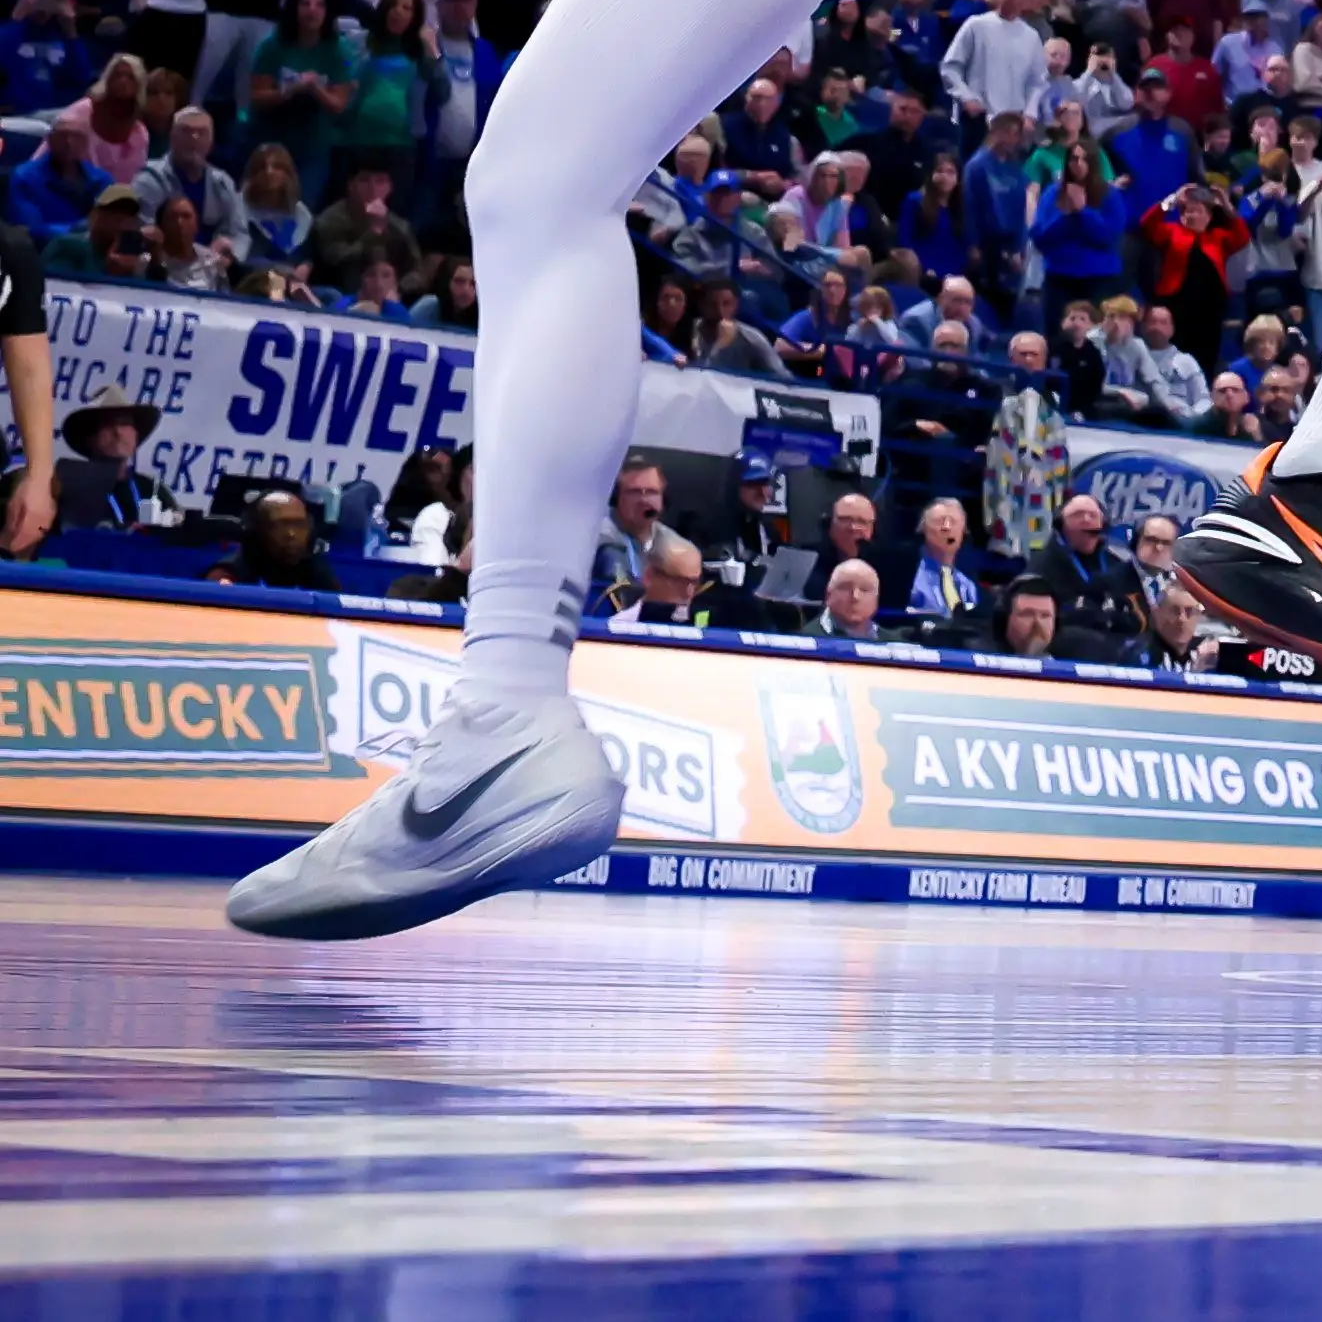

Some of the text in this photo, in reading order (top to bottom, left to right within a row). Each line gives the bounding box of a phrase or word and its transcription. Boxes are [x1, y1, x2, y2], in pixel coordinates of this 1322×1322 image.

[123, 305, 200, 360] THE
[1089, 469, 1206, 526] KHSAA
[1262, 647, 1315, 677] POSS
[913, 734, 952, 788] A
[955, 737, 1021, 791] KY
[1033, 742, 1246, 806] HUNTING
[1253, 758, 1319, 811] OR
[648, 855, 817, 895] BIG ON COMMITMENT
